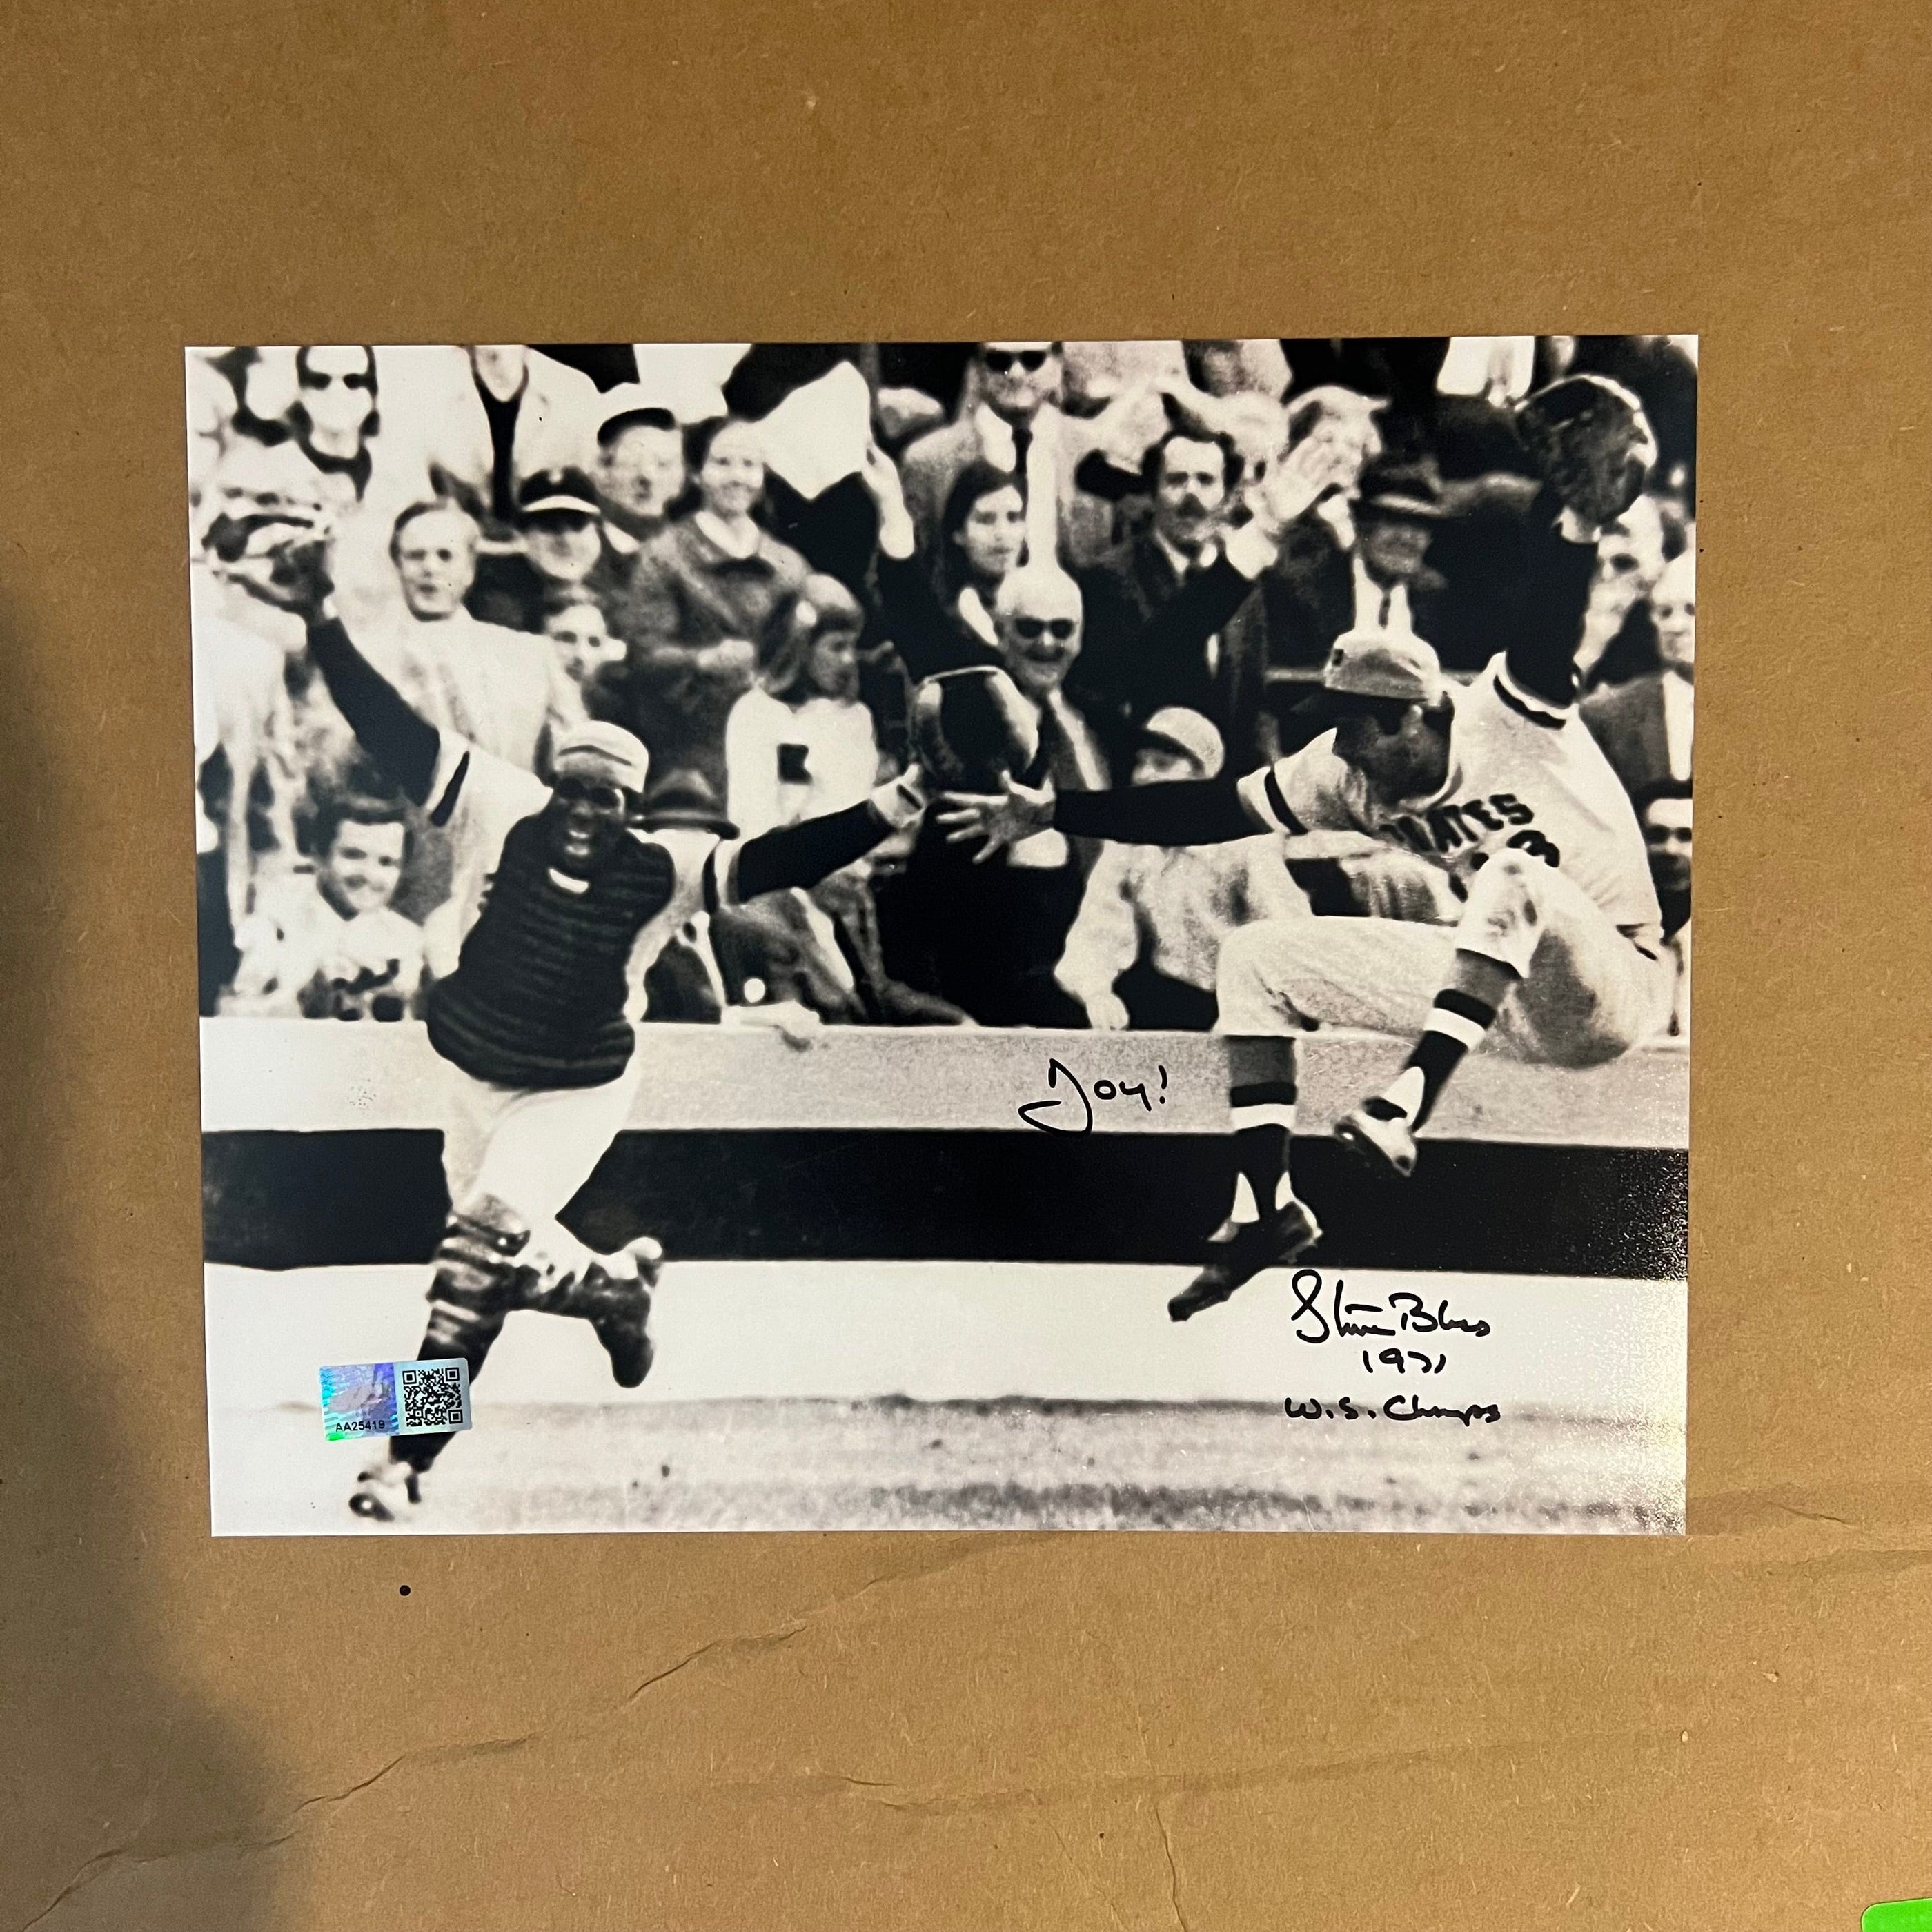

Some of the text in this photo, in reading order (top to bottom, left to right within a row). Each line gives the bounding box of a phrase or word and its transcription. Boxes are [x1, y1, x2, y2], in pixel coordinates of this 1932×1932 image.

[1018, 1058, 1168, 1137] Joy!
[1363, 1348, 1446, 1373] 1971
[335, 1419, 386, 1432] AA25419
